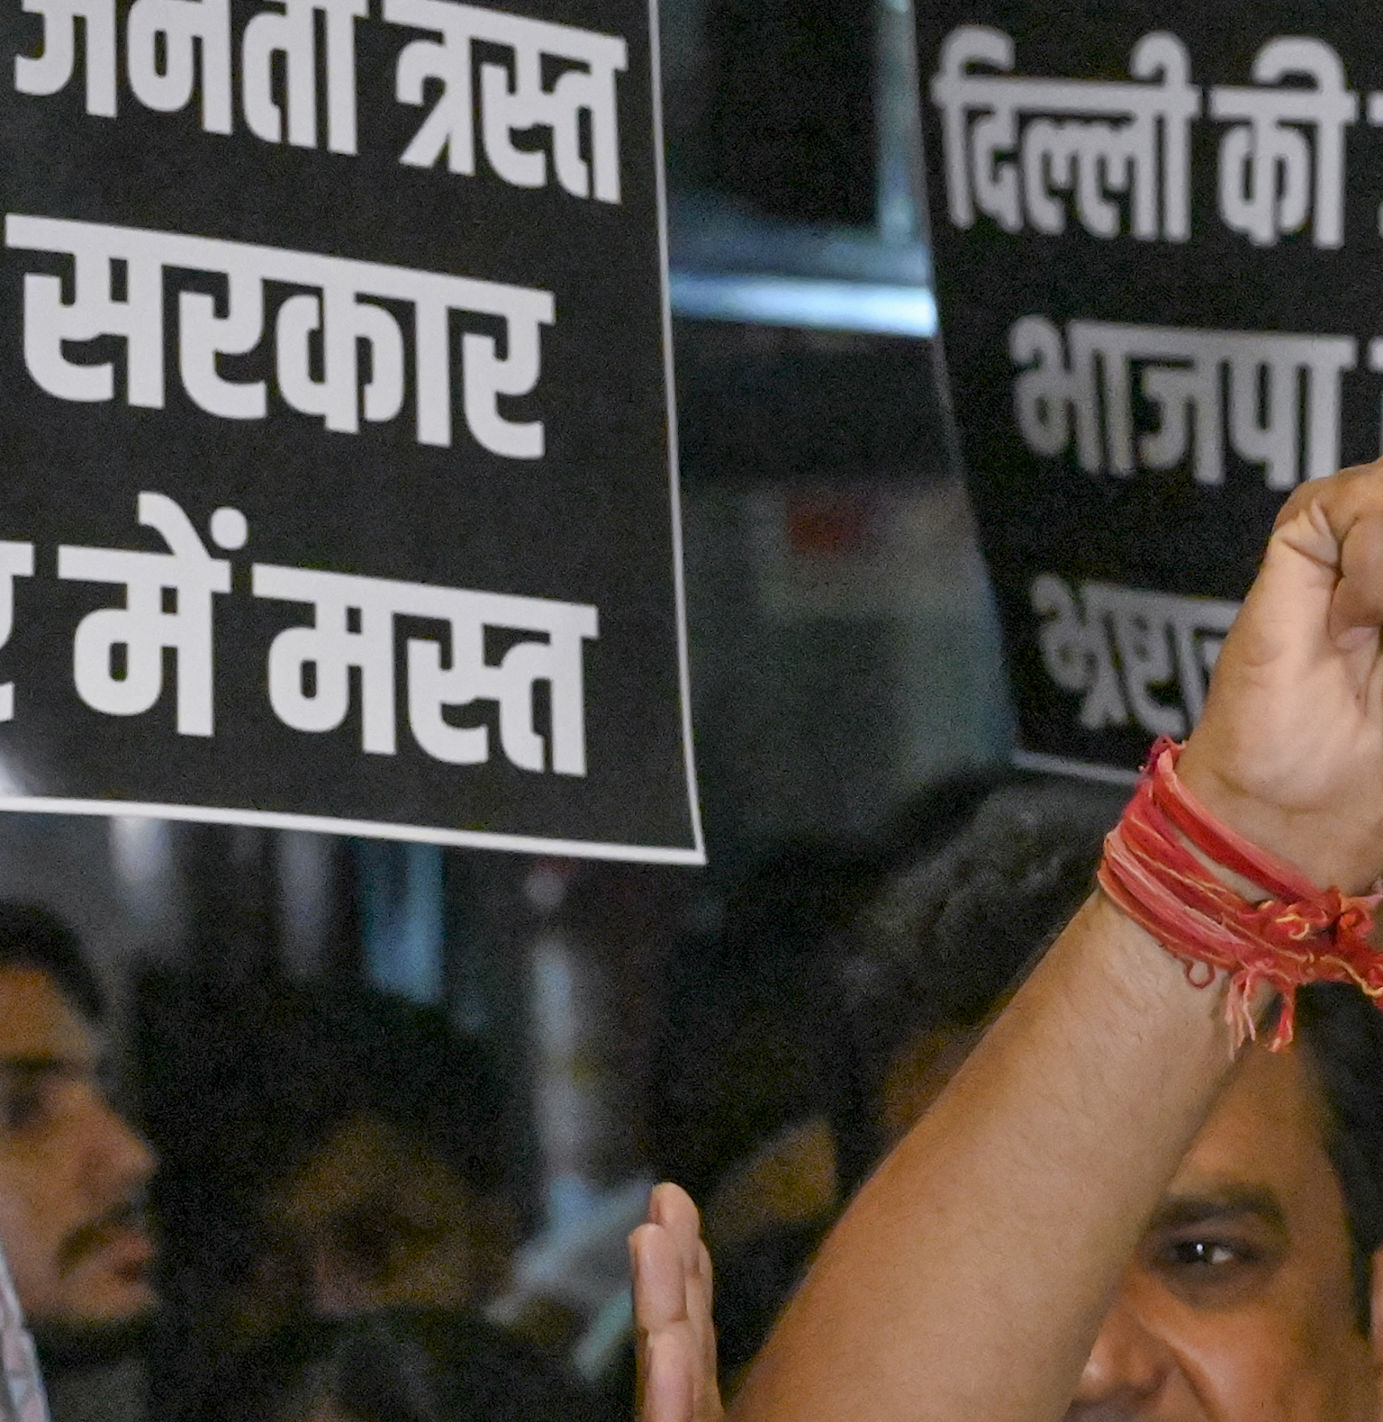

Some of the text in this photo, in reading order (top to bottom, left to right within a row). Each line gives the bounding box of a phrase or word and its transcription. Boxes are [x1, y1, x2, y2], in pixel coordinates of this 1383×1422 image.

[383, 0, 626, 203] त्रस्त
[935, 29, 1199, 239] दिल्ली
[1211, 39, 1356, 247] की
[6, 214, 554, 458] सरकार
[1016, 320, 1355, 486] भाजपा
[58, 492, 247, 736] में
[252, 564, 597, 775] मस्त
